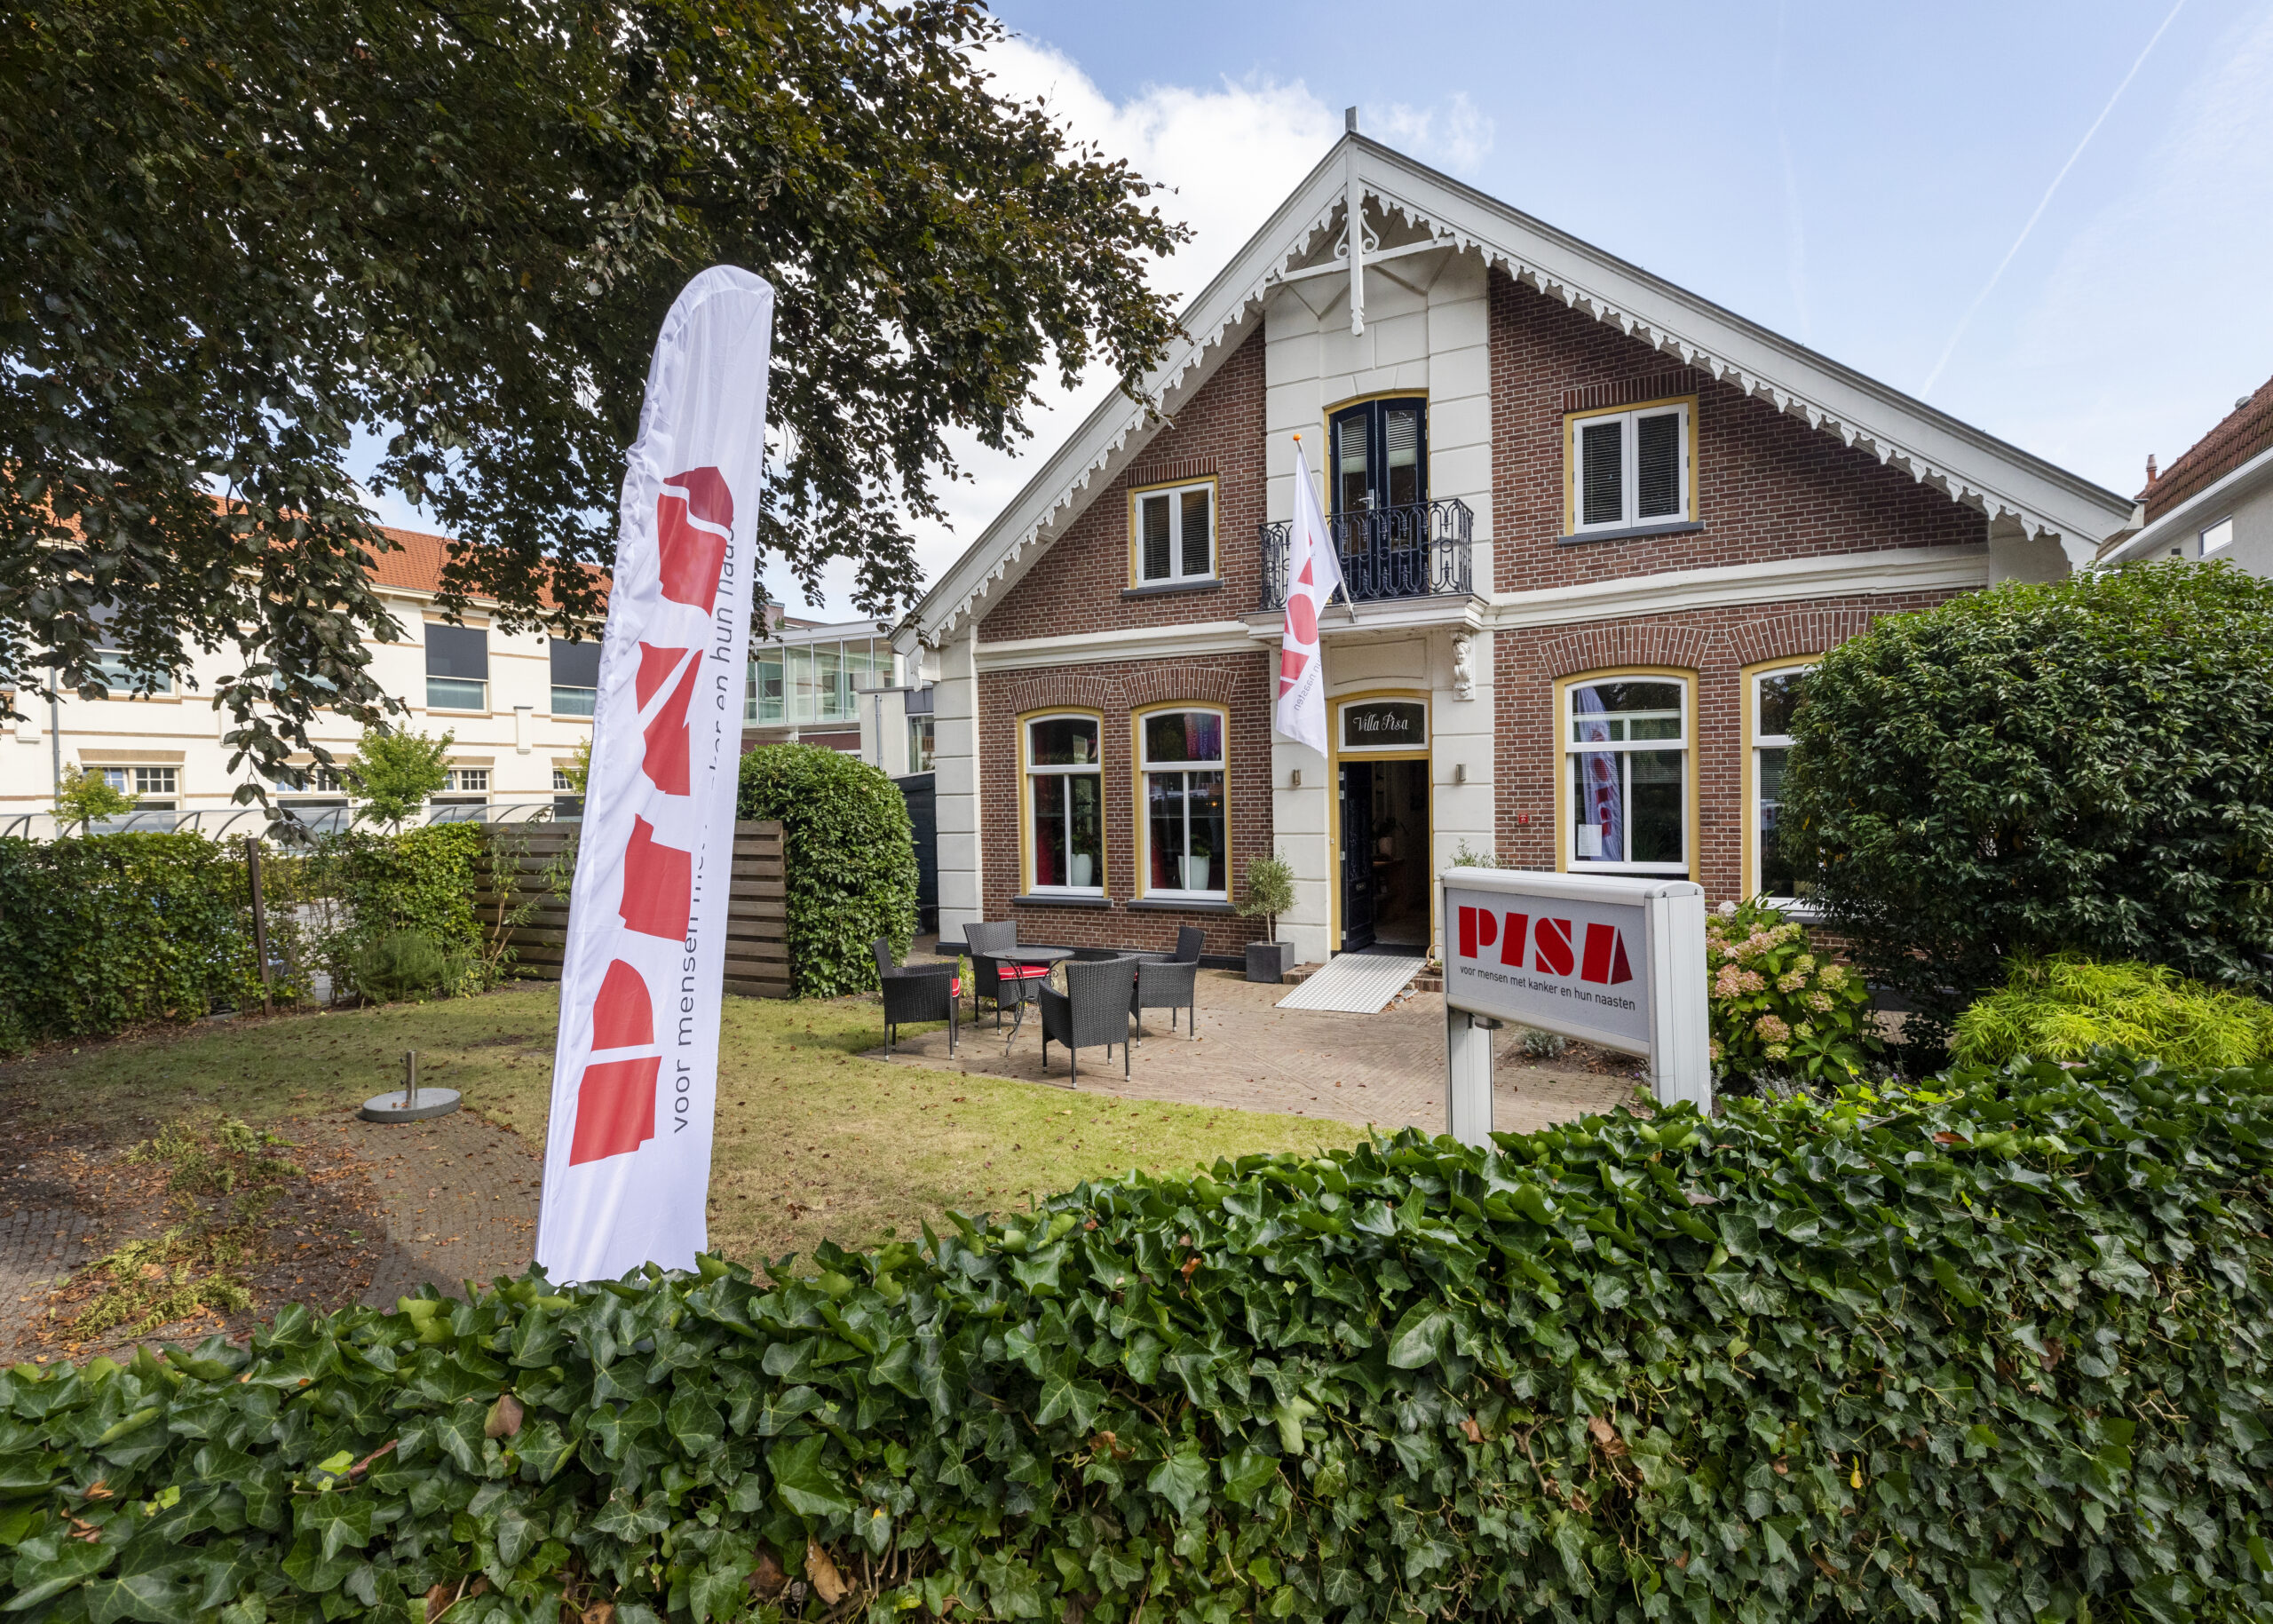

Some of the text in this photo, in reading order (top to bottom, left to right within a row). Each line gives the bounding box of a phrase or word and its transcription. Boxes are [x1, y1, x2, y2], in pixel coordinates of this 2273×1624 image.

[709, 606, 733, 663] hun
[716, 675, 729, 711] en
[1352, 711, 1409, 732] Villa Pisa
[1459, 906, 1634, 986] PISA
[1460, 965, 1635, 1011] voor mensen met kanker en hun naasten
[674, 916, 700, 1134] voor mensen
